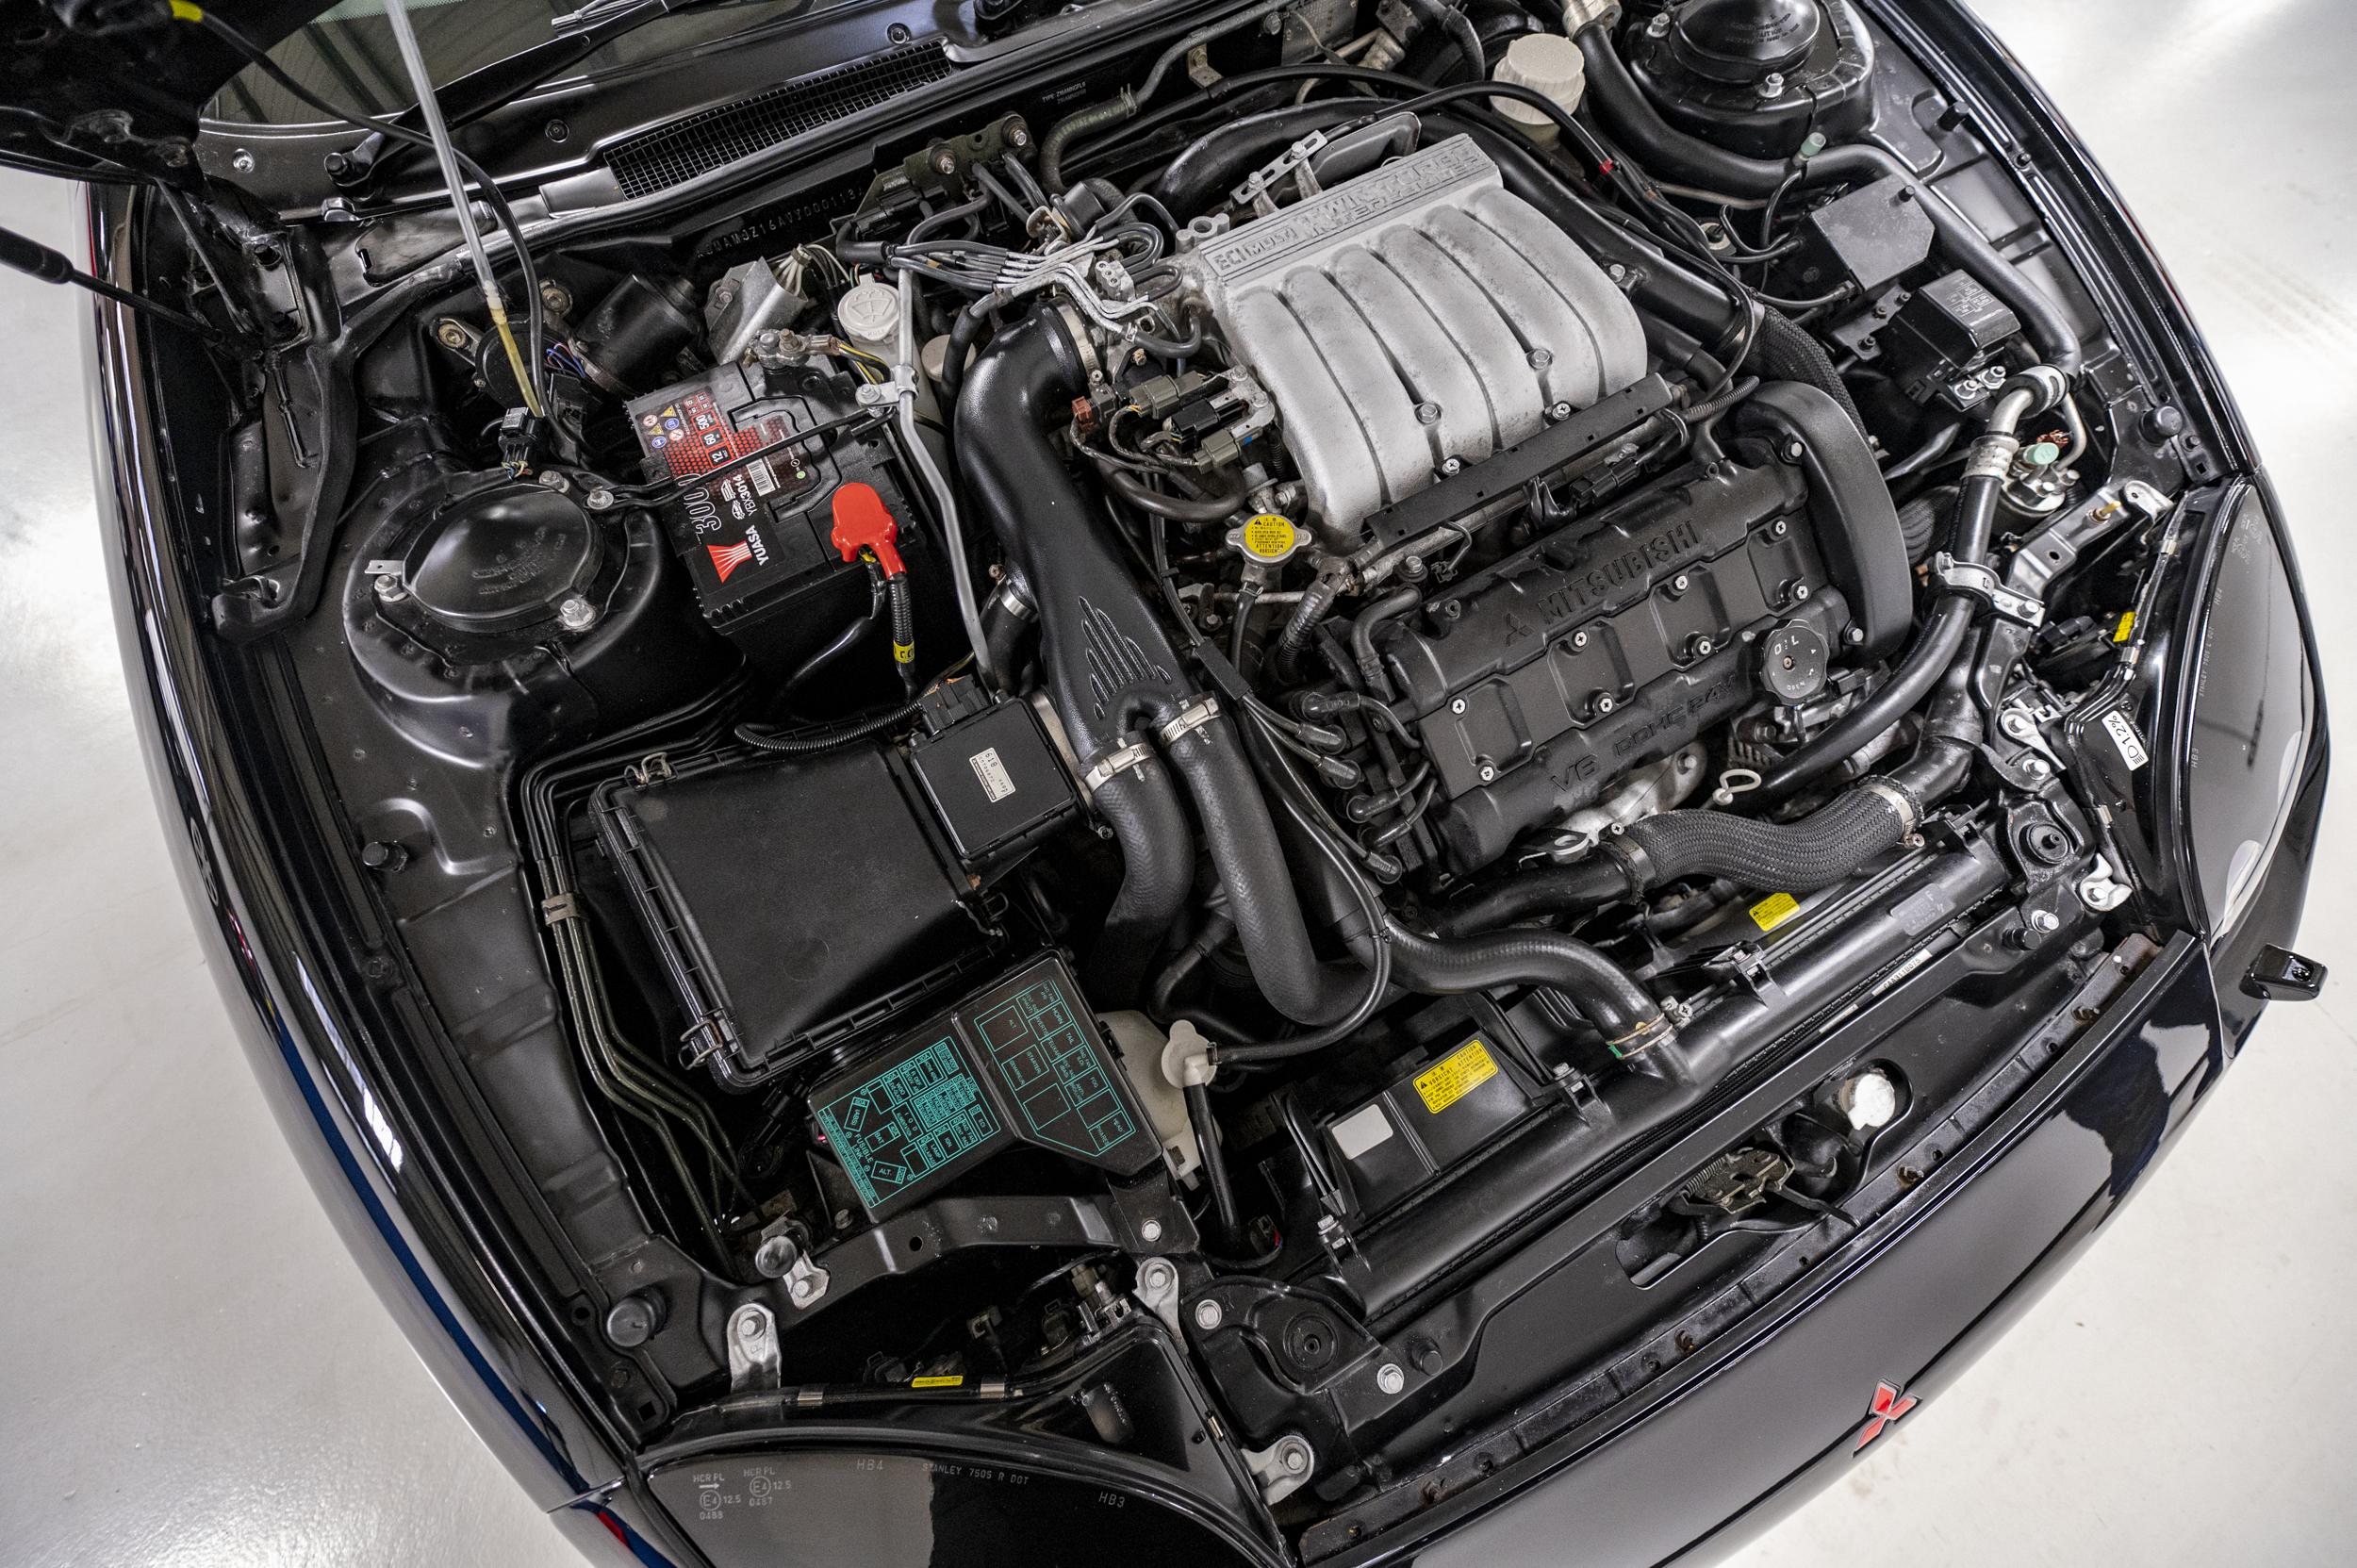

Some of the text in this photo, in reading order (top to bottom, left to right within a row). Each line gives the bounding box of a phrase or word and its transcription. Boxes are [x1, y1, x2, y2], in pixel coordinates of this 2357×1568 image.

[1213, 247, 1245, 272] ECI
[697, 415, 709, 429] 500
[704, 433, 717, 445] 60
[712, 451, 725, 463] 12
[733, 473, 758, 517] YBX3014
[745, 524, 769, 567] YUASA
[1537, 519, 1700, 625] MITSUBISHI
[1774, 635, 1799, 655] OIL
[1787, 681, 1805, 691] OPEN
[1613, 674, 1736, 756] DOHC 24V
[2108, 715, 2131, 745] 1.2%
[985, 752, 997, 767] 618
[2190, 747, 2200, 768] HB3
[1551, 754, 1598, 792] V6
[1052, 1008, 1064, 1025] HORN
[1035, 1016, 1048, 1035] AVERTIS
[1065, 1032, 1075, 1045] TAIL
[1047, 1038, 1061, 1058] FEUXAR
[1458, 1046, 1475, 1059] CAUTION
[1429, 1048, 1482, 1085] VORSICHT ATTENTION
[895, 1082, 906, 1096] WDO
[965, 1077, 978, 1093] FUSE
[1090, 1077, 1098, 1088] FOG
[850, 1108, 861, 1126] (ABS)
[1113, 1118, 1124, 1132] HEAD
[851, 1144, 864, 1159] LINK
[854, 1134, 874, 1163] FUSIBLE
[931, 1144, 942, 1159] LAMP
[879, 1167, 892, 1176] ALT.
[743, 1466, 776, 1477] HCR PL
[856, 1459, 884, 1471] HB4
[693, 1473, 725, 1483] HCR PL
[922, 1462, 1030, 1485] STANLEY 7505 R DOT
[773, 1479, 792, 1491] 12.5
[722, 1494, 742, 1505] 12.5
[749, 1496, 773, 1507] 0487
[1098, 1491, 1127, 1508] HB3
